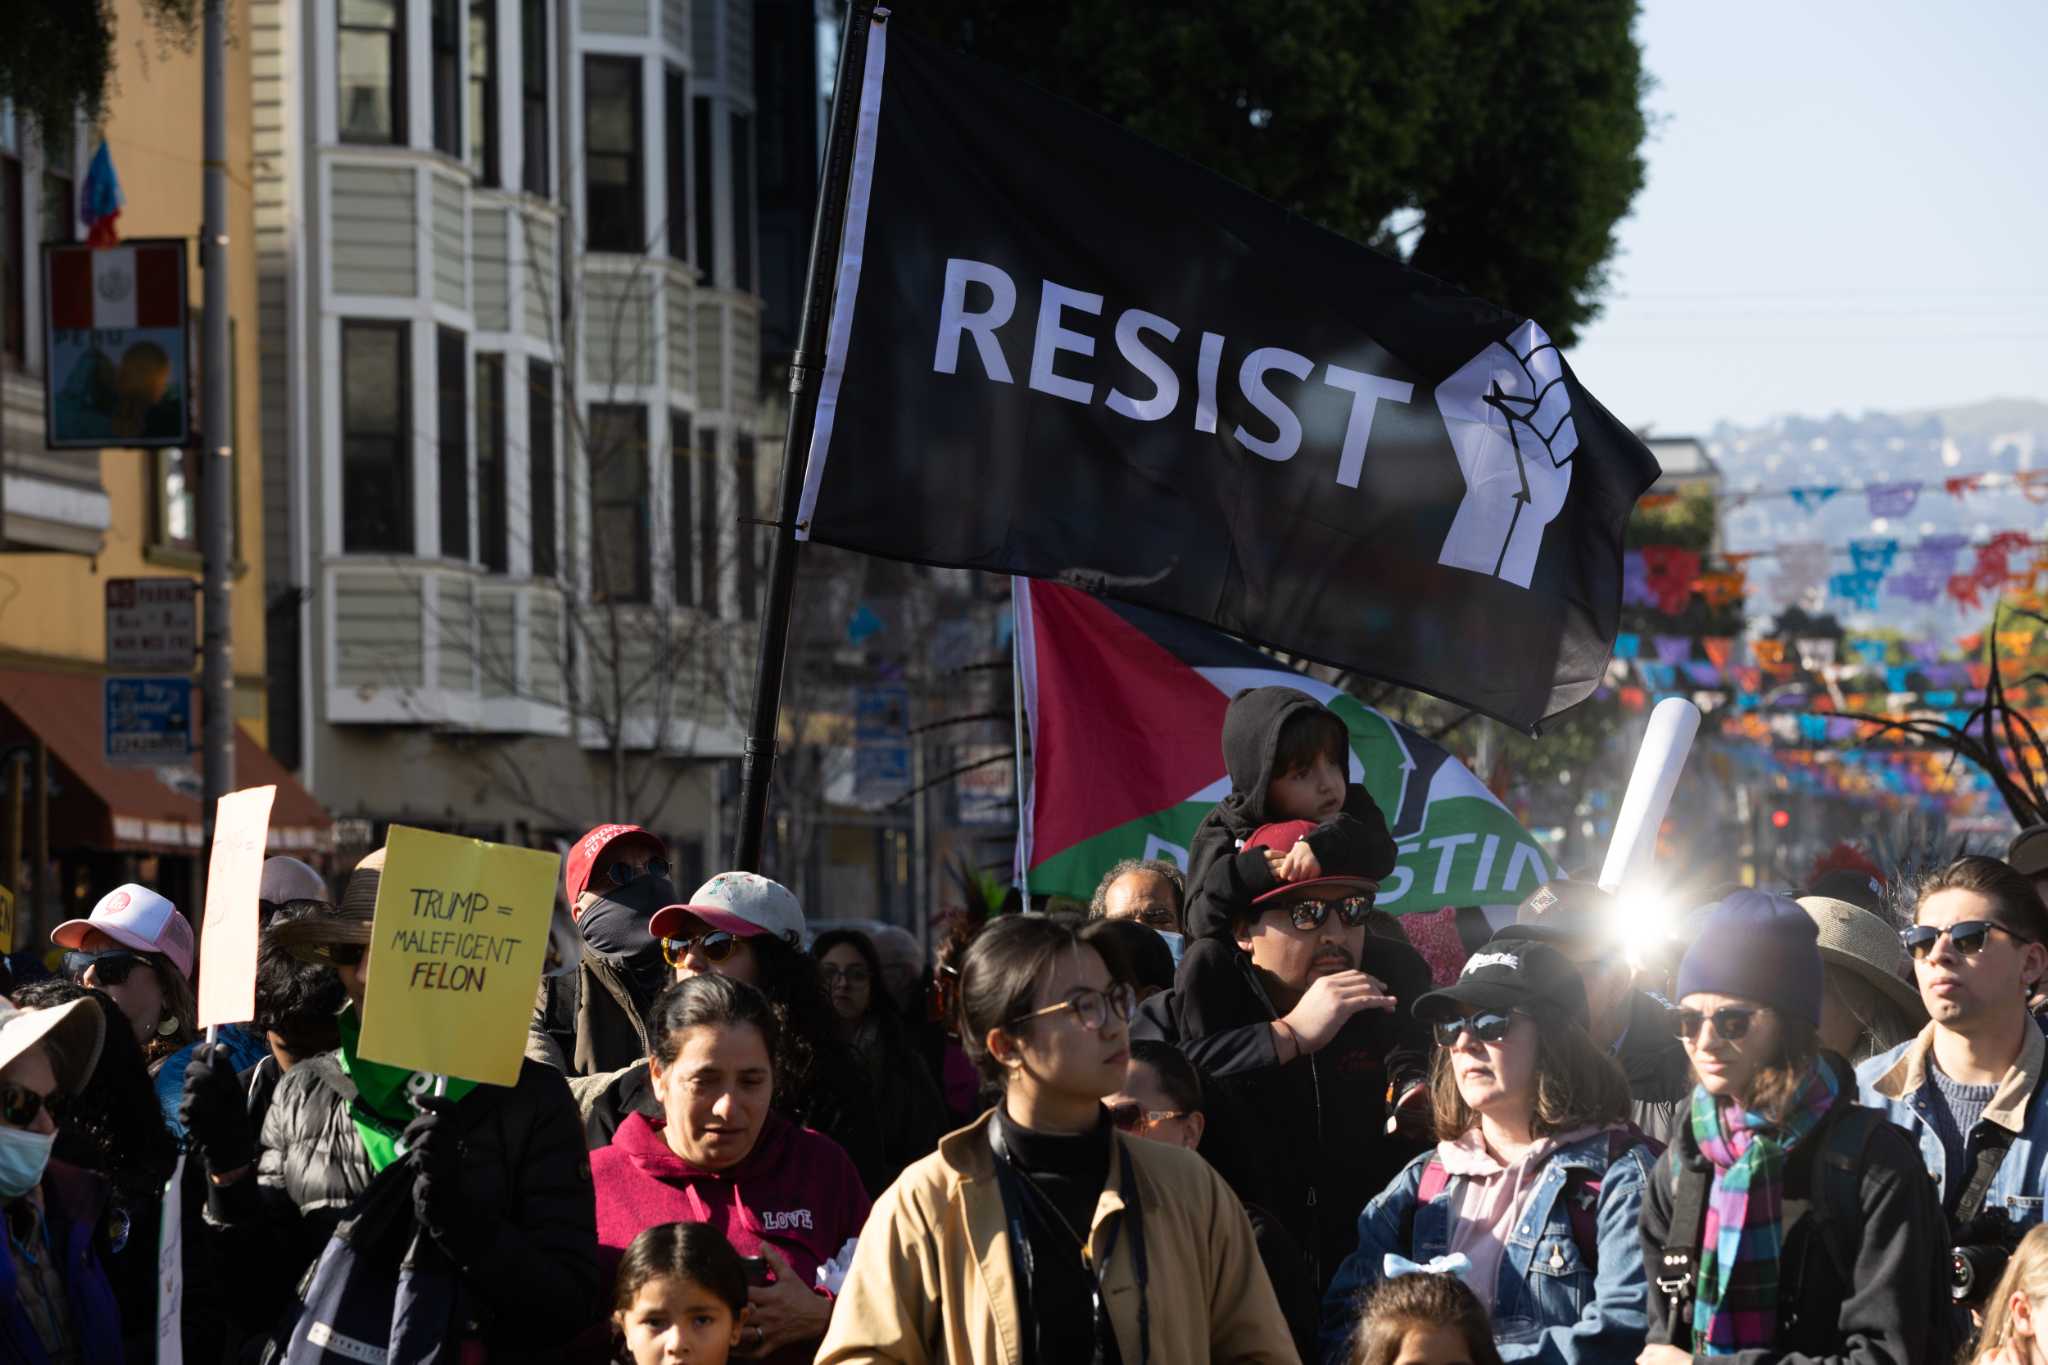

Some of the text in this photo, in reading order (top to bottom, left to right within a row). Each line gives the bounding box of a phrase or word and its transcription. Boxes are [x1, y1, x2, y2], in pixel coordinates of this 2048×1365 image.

[933, 258, 1414, 488] RESIST
[410, 888, 513, 925] TRUMP =
[391, 929, 522, 965] MALEFICENT
[410, 962, 485, 992] FELON
[763, 1208, 813, 1230] LOVE
